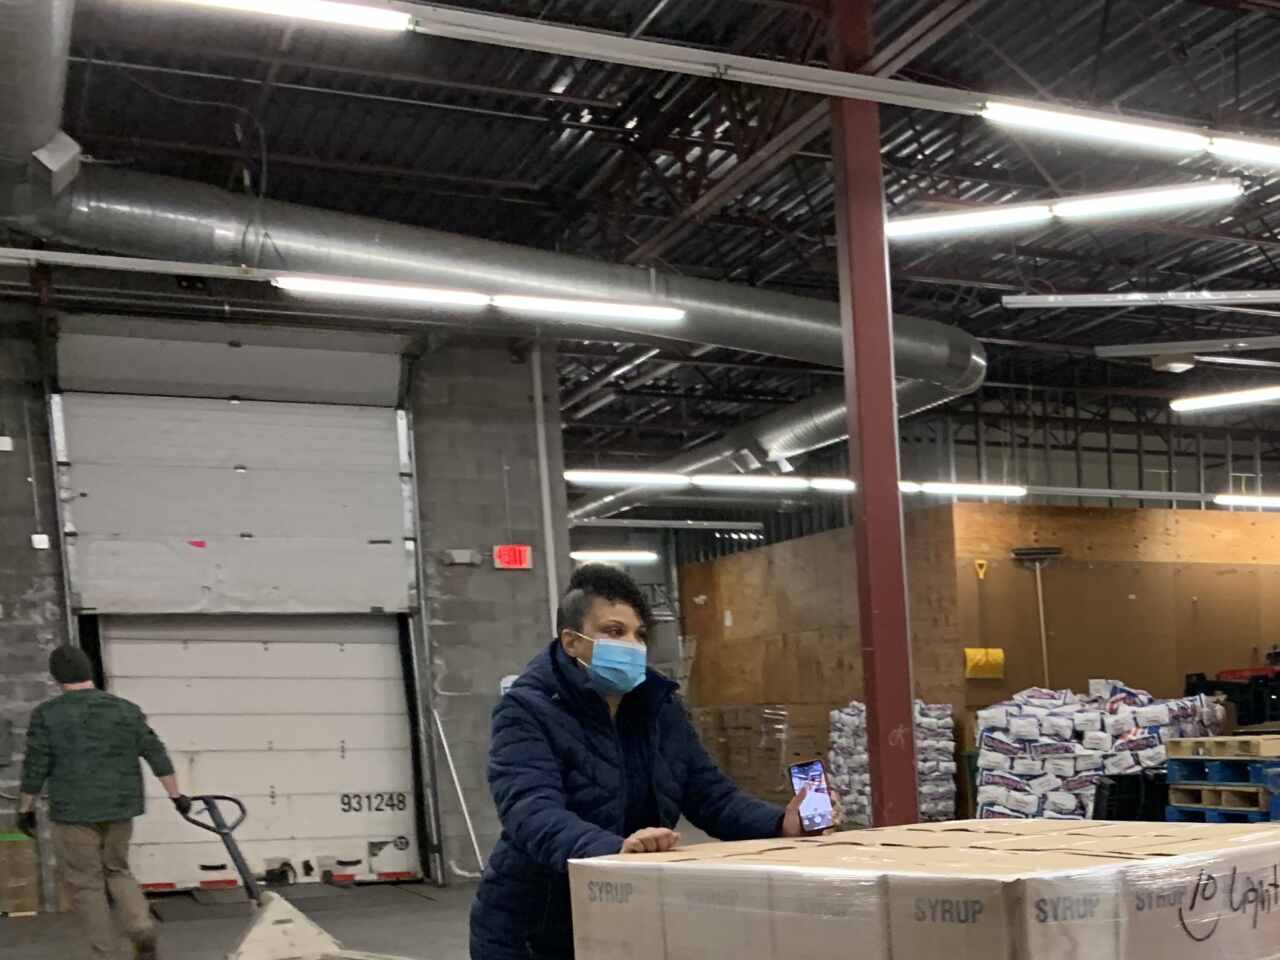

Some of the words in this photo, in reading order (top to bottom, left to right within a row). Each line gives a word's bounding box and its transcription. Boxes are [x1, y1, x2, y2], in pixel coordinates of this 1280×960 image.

[340, 792, 406, 812] 931248
[587, 880, 634, 904] SYRUP
[914, 898, 984, 924] SYRUP
[1034, 895, 1099, 924] SYRUP
